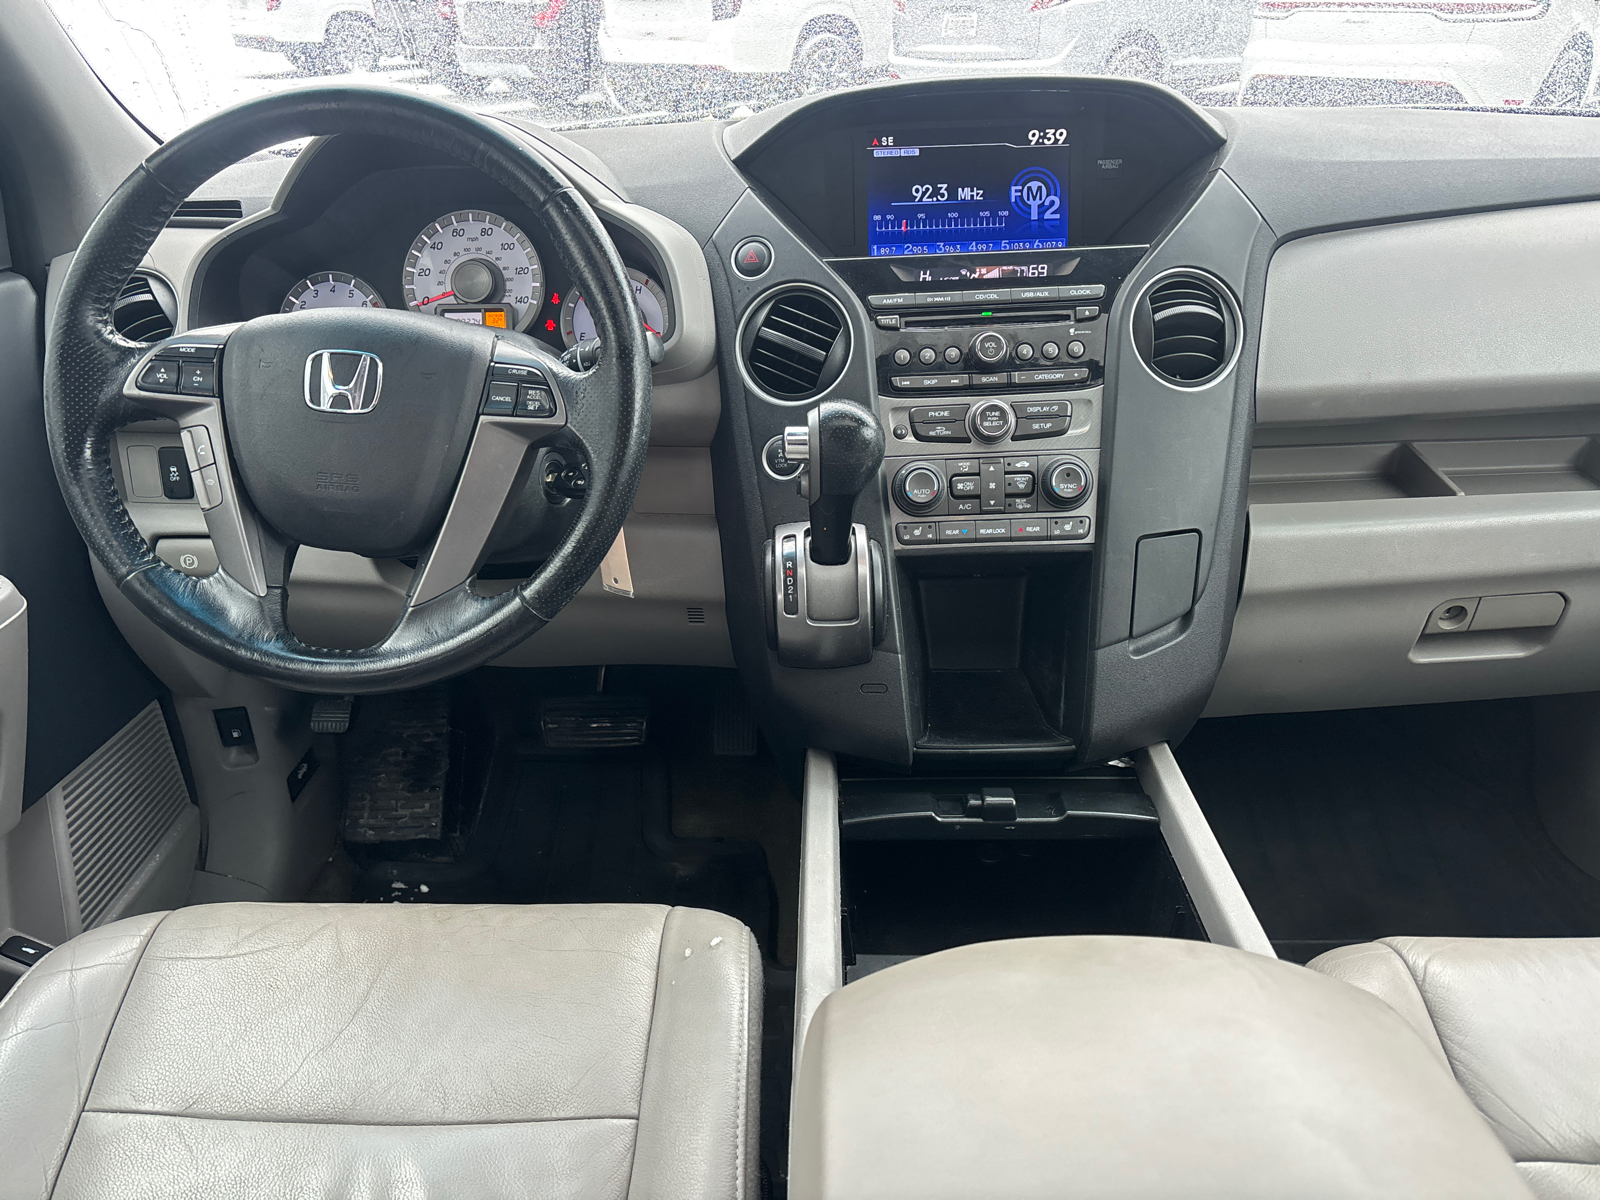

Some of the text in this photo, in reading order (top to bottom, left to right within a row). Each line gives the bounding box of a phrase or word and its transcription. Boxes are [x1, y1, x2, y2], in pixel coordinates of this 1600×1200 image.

[881, 136, 894, 145] SE
[1028, 128, 1068, 145] 9:39
[874, 149, 899, 157] STEREO
[912, 183, 984, 202] 92.3 MHz
[452, 228, 465, 237] 60
[480, 227, 494, 236] 80
[430, 241, 444, 250] 40
[500, 242, 515, 251] 100
[904, 243, 928, 254] 2 90.5
[936, 242, 961, 253] 3 96.3
[968, 241, 993, 251] 4 99.7
[1001, 240, 1030, 250] 5 103.9
[1033, 239, 1042, 249] 6
[880, 247, 896, 255] 89.7
[418, 267, 431, 277] 20
[514, 266, 529, 275] 120
[1029, 263, 1048, 277] 69
[312, 289, 319, 298] 3
[329, 285, 336, 293] 4
[347, 289, 354, 298] 5
[634, 286, 642, 294] H
[300, 300, 307, 309] 2
[361, 300, 368, 308] 6
[422, 296, 430, 305] 0
[514, 296, 529, 304] 140
[579, 332, 586, 340] E
[984, 341, 997, 349] VOL
[925, 352, 930, 360] 2
[507, 368, 528, 376] CRUISE
[923, 378, 938, 386] SKIP
[1032, 422, 1052, 430] SETUP
[787, 577, 794, 585] D
[787, 585, 794, 593] 2
